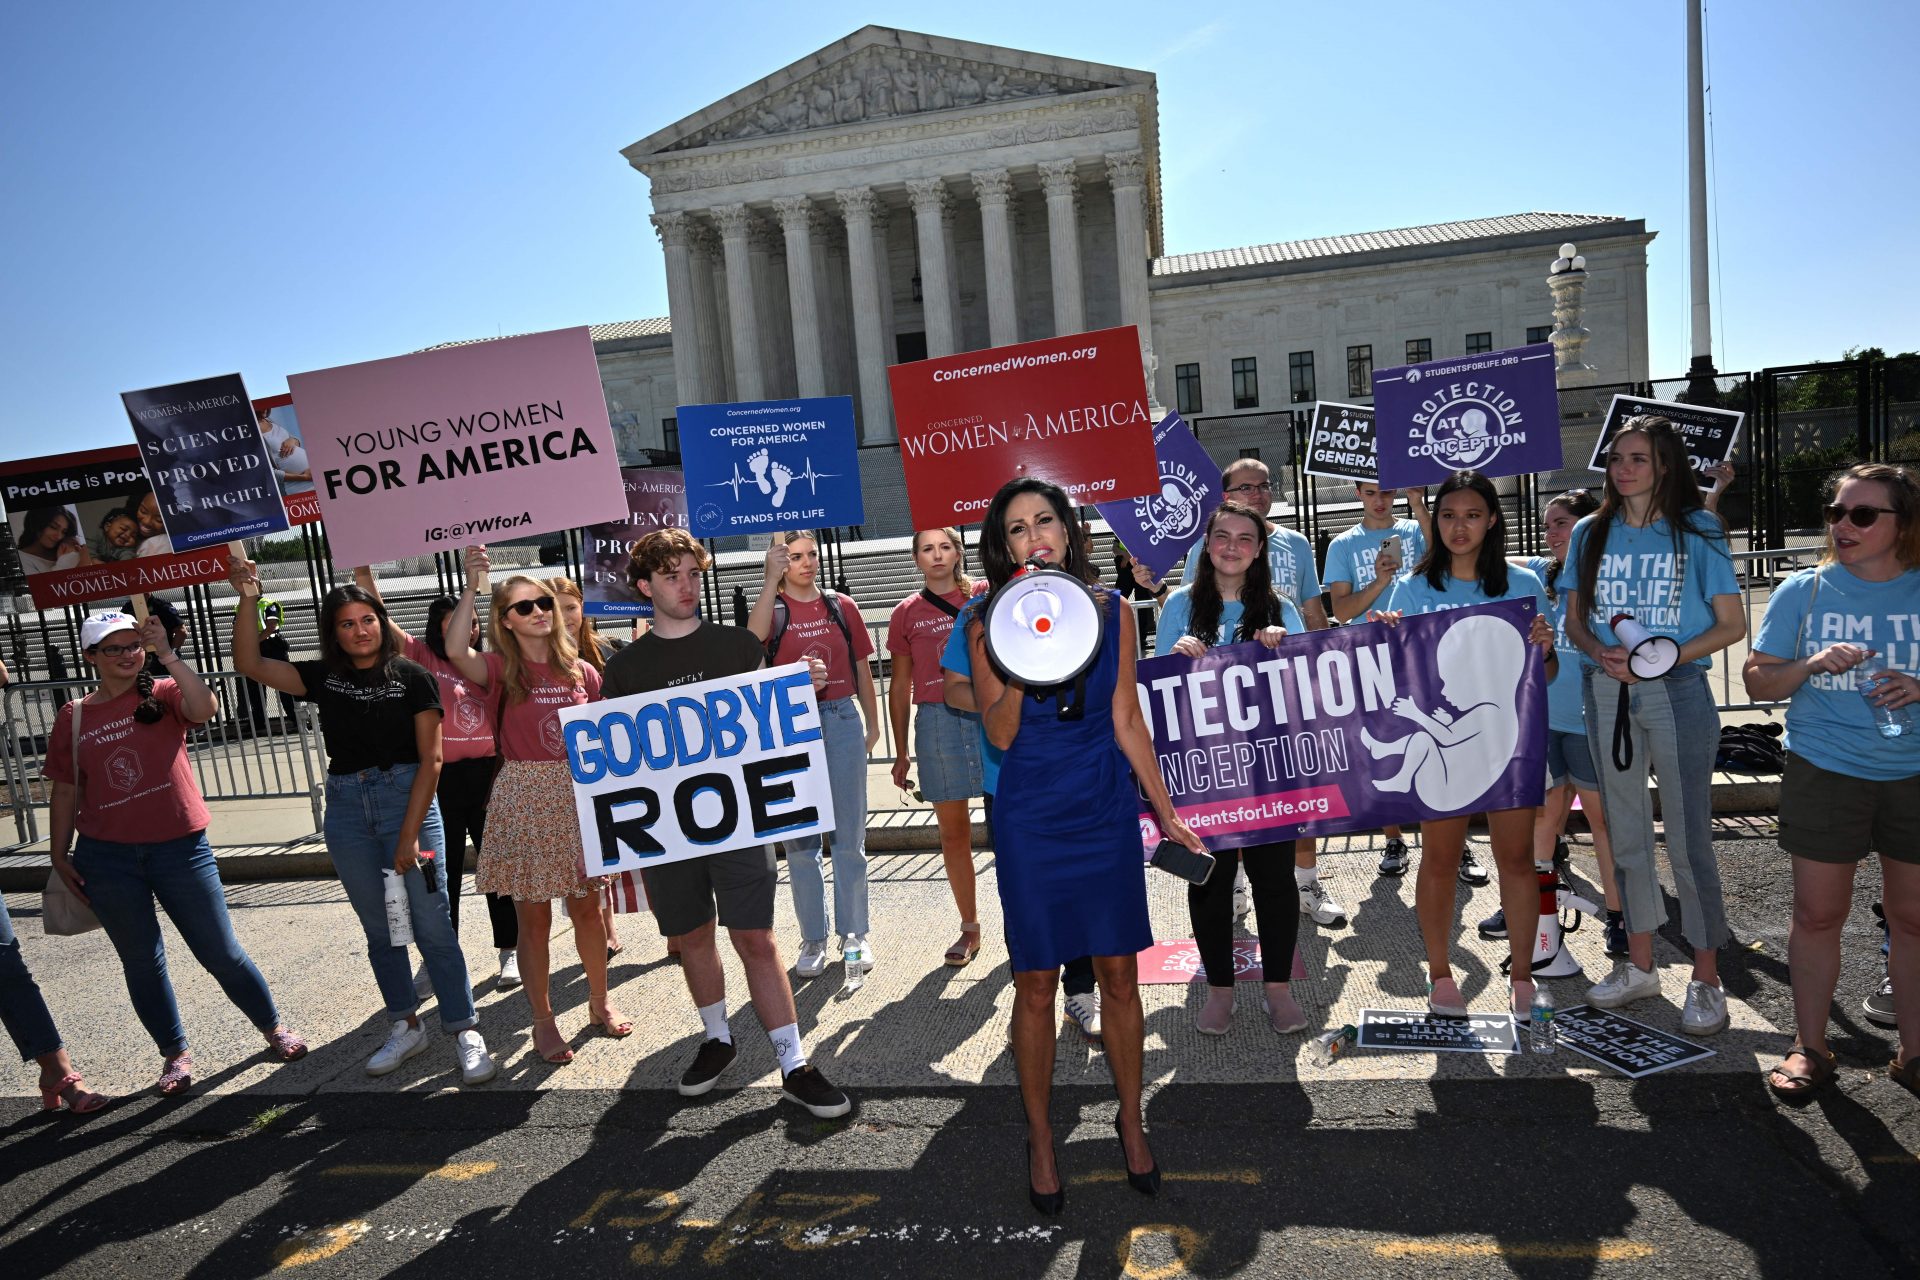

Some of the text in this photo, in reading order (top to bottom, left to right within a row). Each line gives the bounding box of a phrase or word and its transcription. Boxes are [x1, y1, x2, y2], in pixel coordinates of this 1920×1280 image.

[932, 346, 1097, 383] ConcernedWomen.org
[1425, 356, 1519, 378] STUDENTSFORLIFE.ORG
[136, 394, 240, 421] WOMEN AMERICA
[726, 405, 801, 417] ConcernedWomen.org
[1409, 382, 1523, 438] PROTECTION
[1642, 407, 1718, 424] STUDENTSFORLIFE.ORG
[336, 400, 564, 457] YOUNG WOMEN
[710, 420, 826, 437] CONCERNED WOMEN
[903, 421, 1008, 458] WOMEN
[1024, 400, 1149, 440] AMERICA
[927, 414, 983, 431] CONCERNED
[1324, 416, 1368, 433] I AM
[1437, 417, 1459, 430] AT
[1707, 428, 1722, 439] IS
[146, 424, 252, 456] SCIENCE
[731, 433, 808, 447] FOR AMERICA
[1408, 431, 1526, 458] CONCEPTION
[156, 453, 260, 487] PROVED
[323, 427, 598, 499] FOR AMERICA
[7, 477, 80, 499] Pro-Life
[85, 474, 100, 488] is
[166, 486, 272, 516] US RIGHT.
[1152, 496, 1166, 514] AT
[730, 508, 825, 525] STANDS FOR LIFE
[1149, 483, 1209, 546] CONCEPTION
[187, 520, 269, 542] ConcernedWomen.org
[425, 511, 532, 542] IG:@YWforA
[1353, 552, 1360, 567] I
[1597, 553, 1688, 579] AM THE
[50, 558, 225, 599] WOMEN AMERICA
[66, 569, 108, 580] CONCERNED
[594, 571, 617, 583] US
[1595, 580, 1683, 606] RO-LIFE
[797, 627, 830, 639] AMERICA
[1821, 612, 1873, 641] AM
[535, 696, 573, 704] AMERICA
[78, 728, 101, 744] OUNG
[94, 727, 134, 746] AMERICA
[563, 670, 823, 784] GOODBYE
[1138, 728, 1349, 801] NCEPTION
[591, 752, 819, 866] ROE
[1367, 1016, 1508, 1029] ABORTION
[1400, 1025, 1476, 1036] ANTI-
[1396, 1033, 1462, 1042] FUTURE
[1554, 1013, 1677, 1064] PRO-LIFE
[1589, 1018, 1629, 1033] AM
[1635, 1033, 1686, 1056] THE
